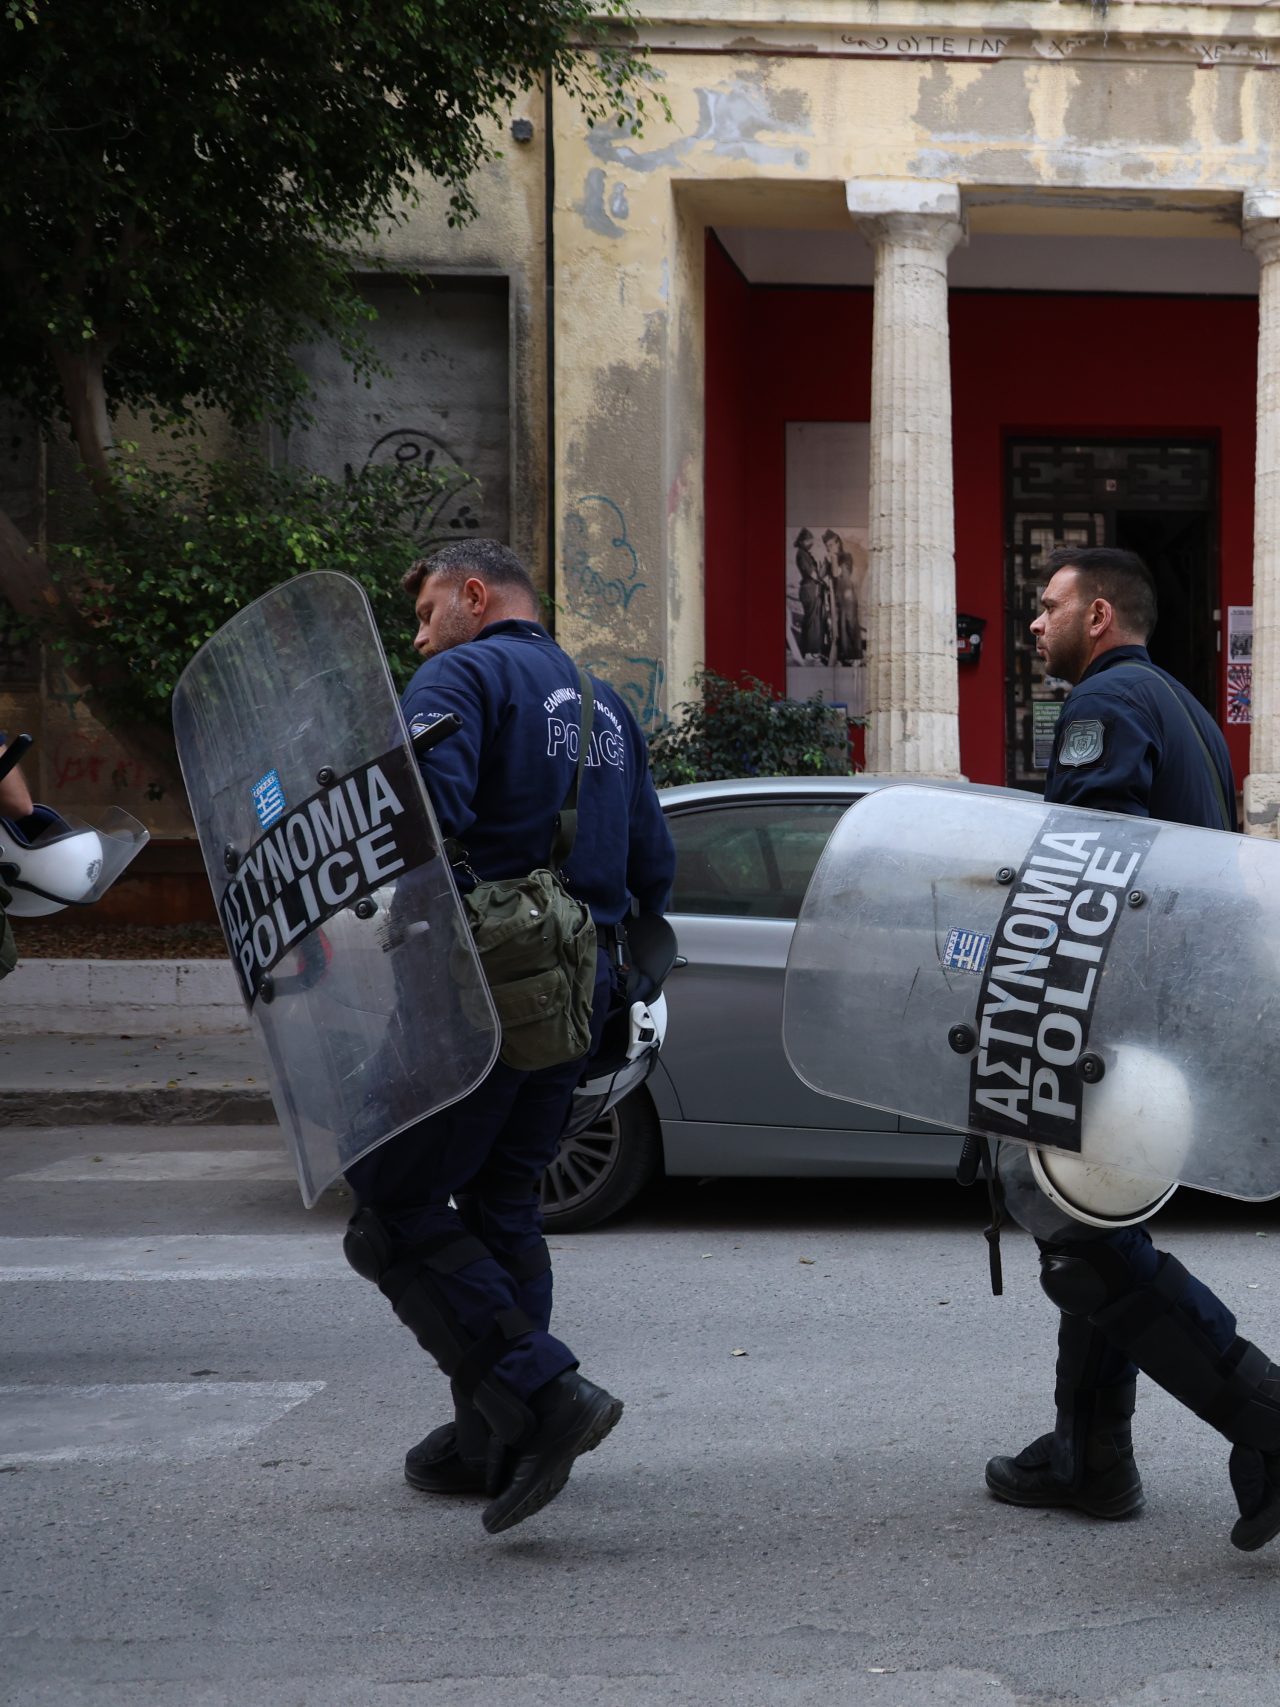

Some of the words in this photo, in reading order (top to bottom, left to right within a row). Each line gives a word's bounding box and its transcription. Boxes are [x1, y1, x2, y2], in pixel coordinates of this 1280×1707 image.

[897, 35, 954, 54] ΟΥΤΕ
[224, 764, 405, 957] ΑΣΤΥΝΟΜΙΑ
[239, 823, 405, 996] POLICE
[975, 831, 1101, 1126] ΑΣΤΥΝΟΜΙΑ
[1031, 846, 1141, 1121] POLICE
